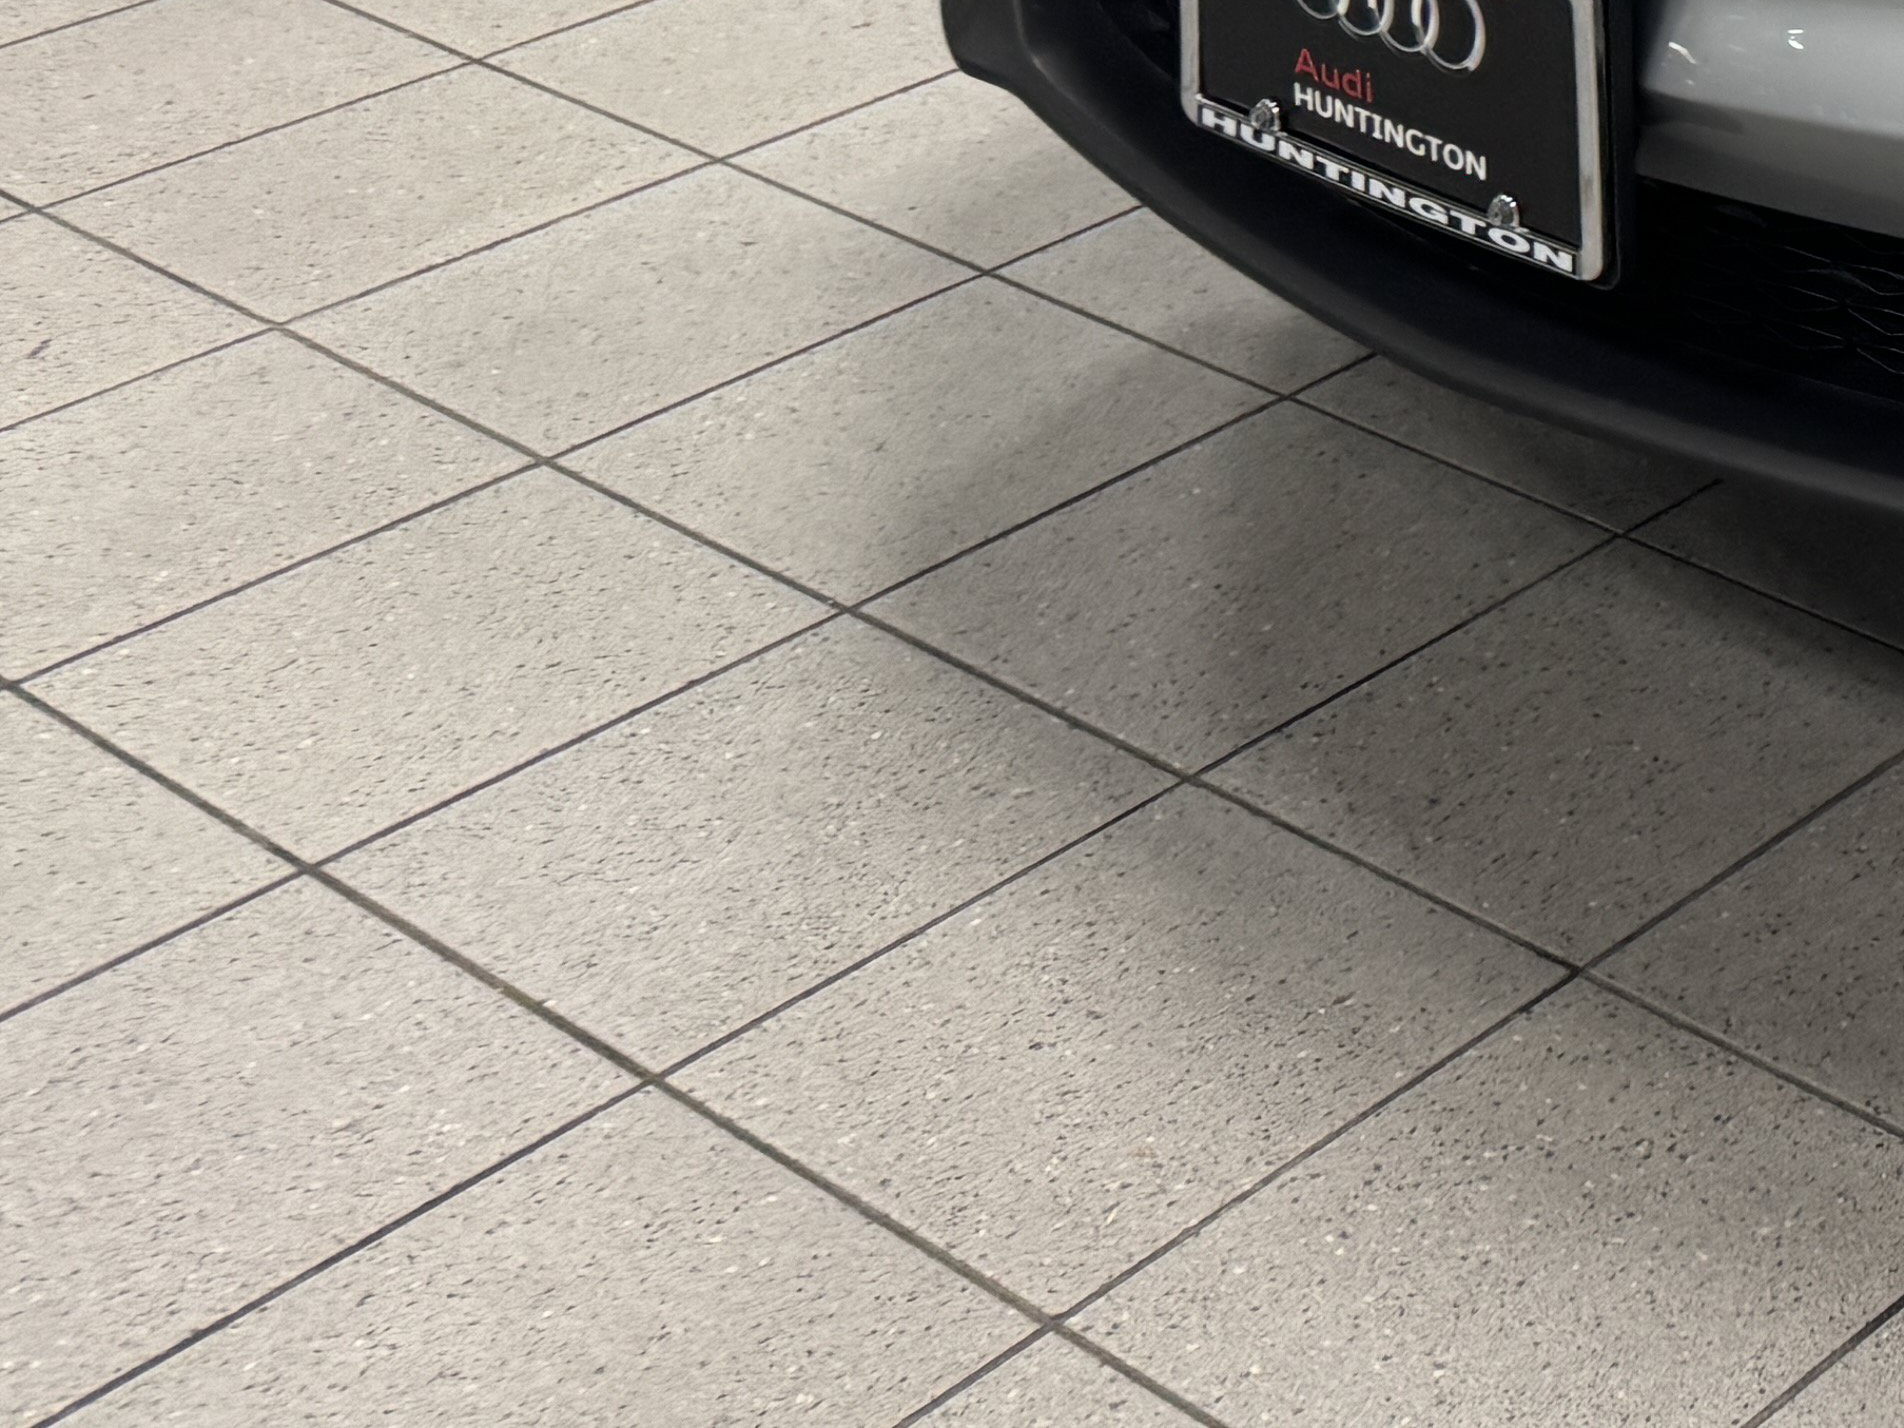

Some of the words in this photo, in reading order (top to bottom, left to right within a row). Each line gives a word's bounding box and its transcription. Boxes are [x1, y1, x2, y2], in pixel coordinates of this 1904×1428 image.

[1293, 48, 1374, 103] Audi
[1293, 82, 1488, 182] HUNTINGTON
[1201, 108, 1574, 273] HUNTINGTON
